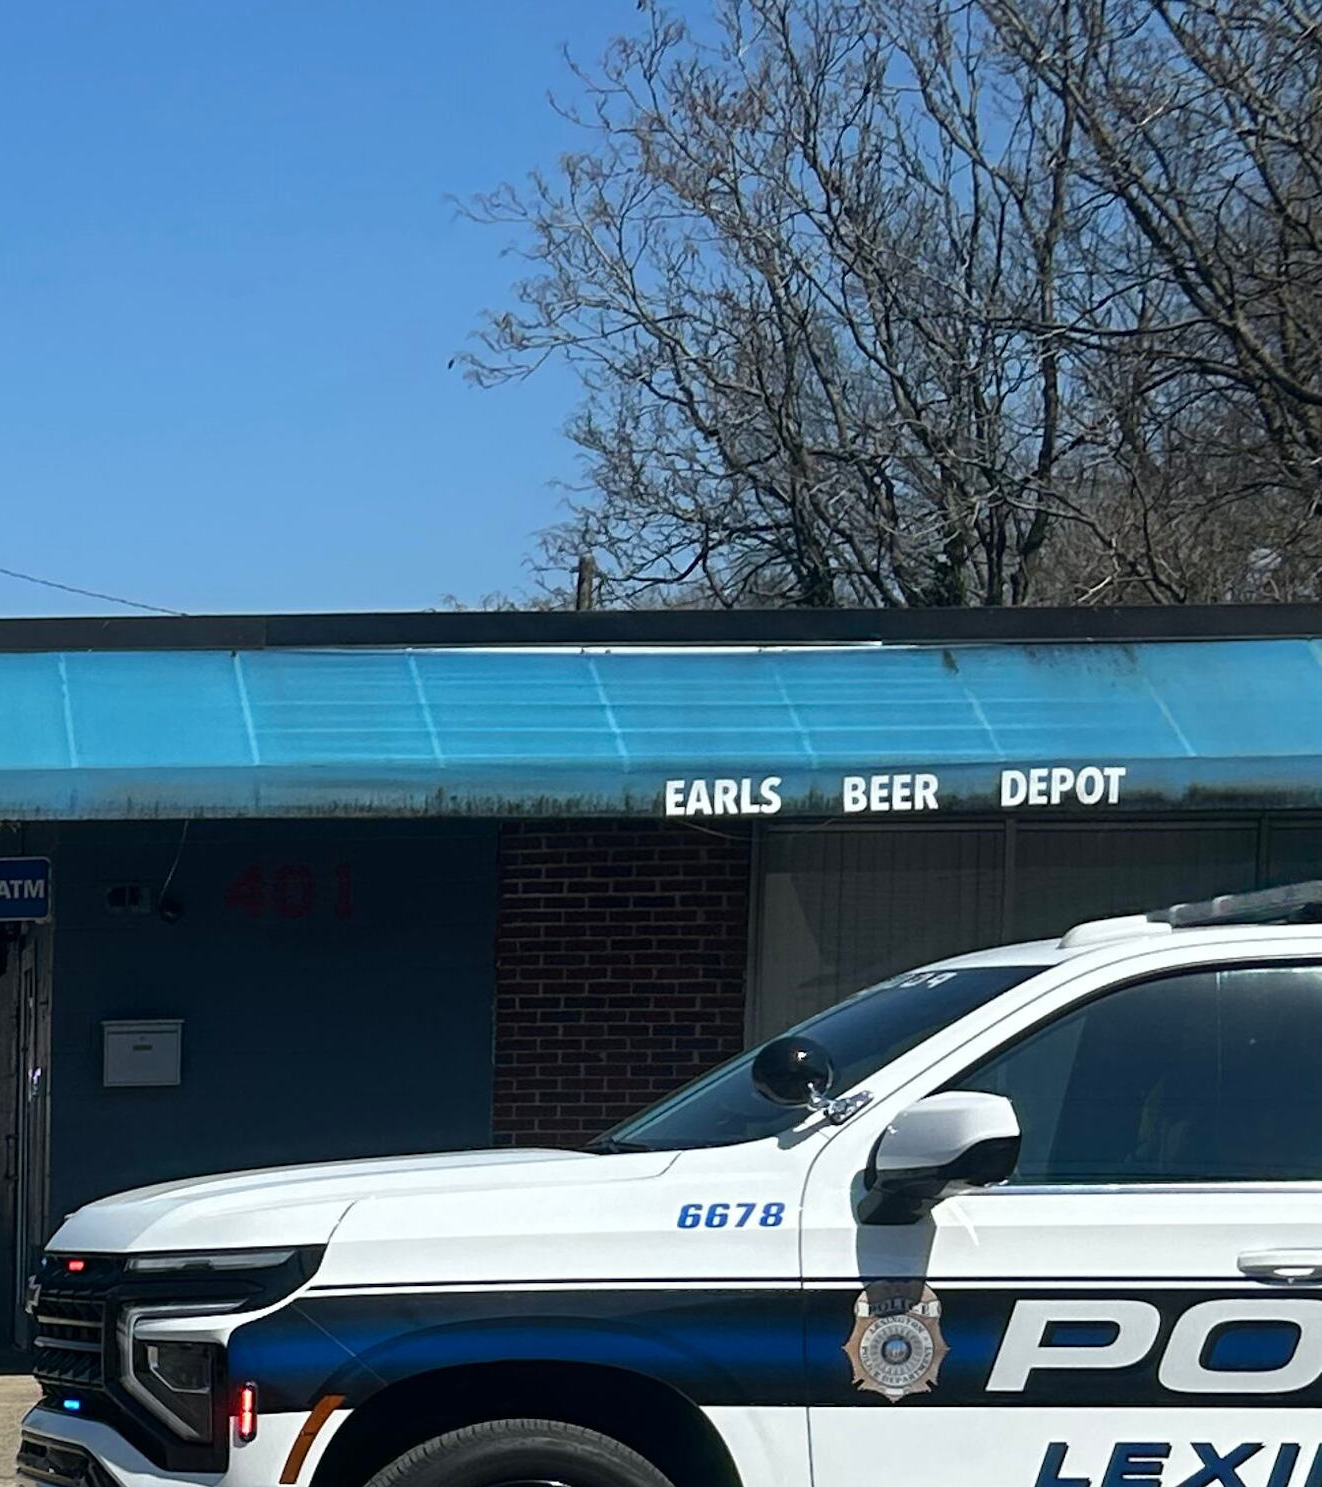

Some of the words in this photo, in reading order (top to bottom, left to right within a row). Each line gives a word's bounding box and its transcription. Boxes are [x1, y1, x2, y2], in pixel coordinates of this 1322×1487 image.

[665, 776, 782, 816] EARLS
[843, 773, 939, 812] BEER
[1000, 767, 1126, 807] DEPOT
[221, 862, 354, 920] 401
[676, 1202, 786, 1228] 6678
